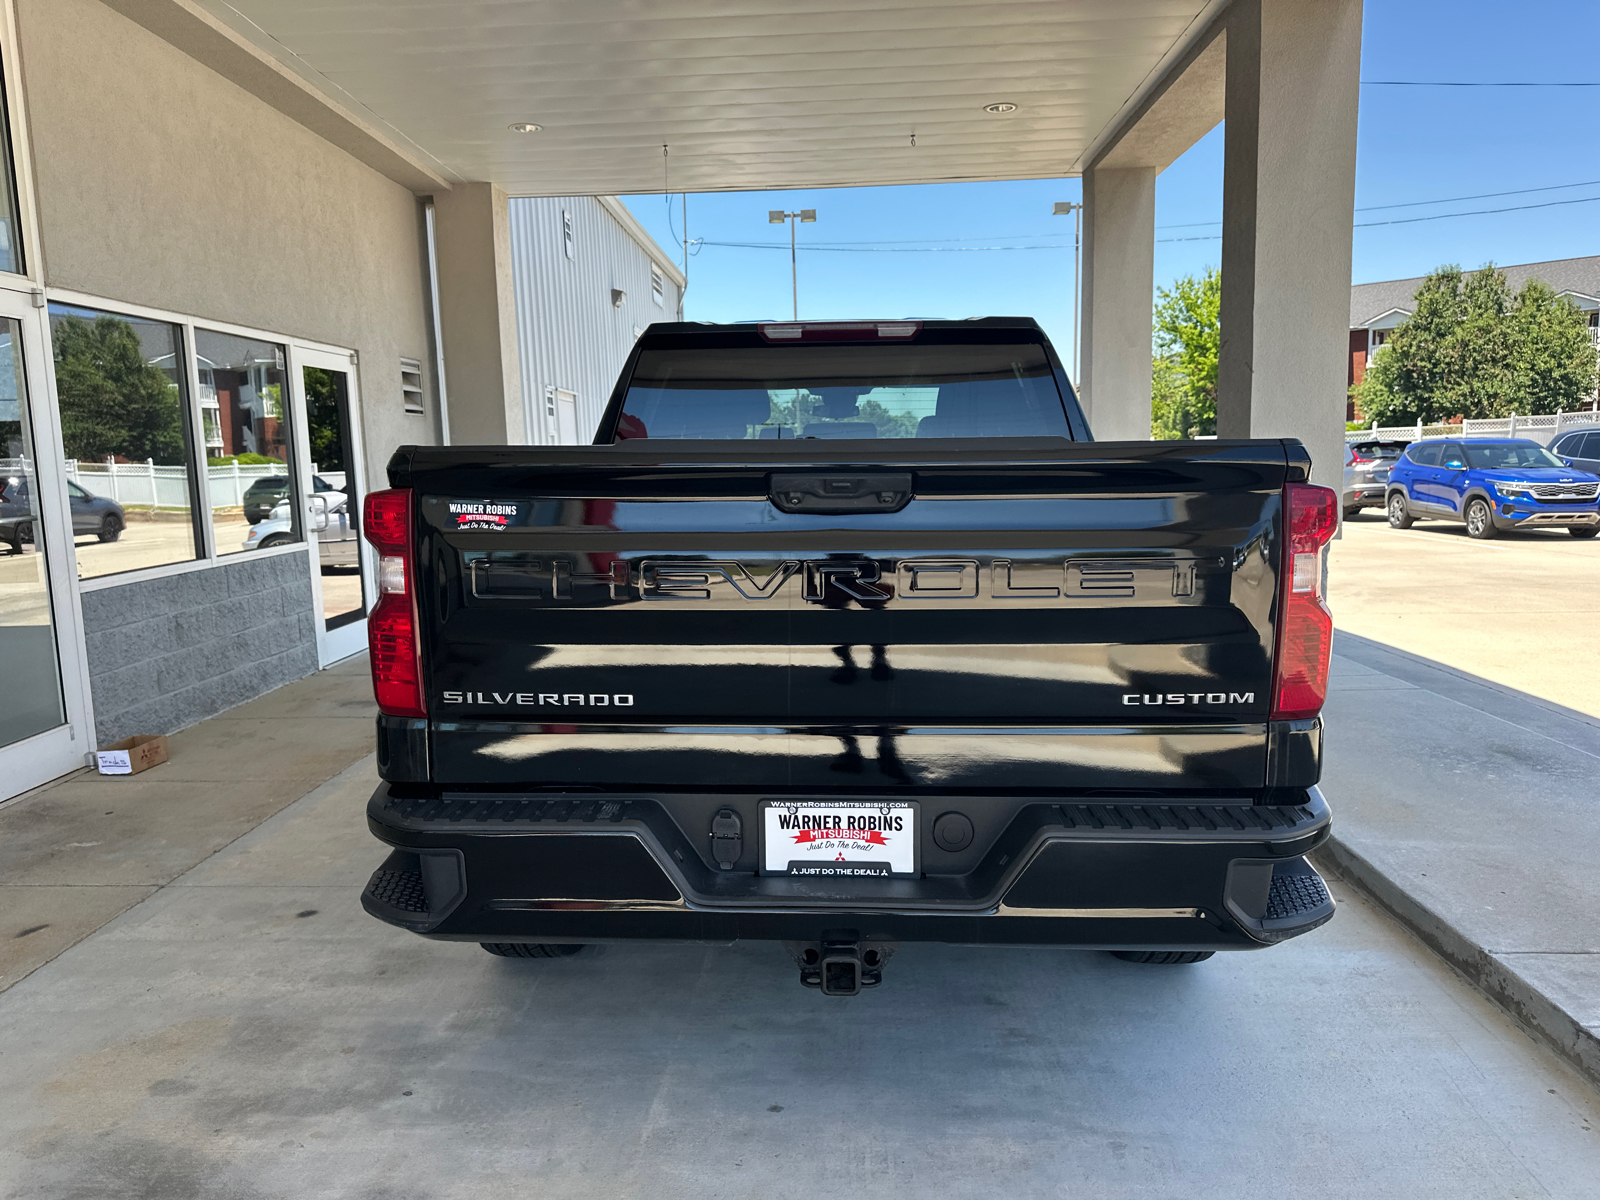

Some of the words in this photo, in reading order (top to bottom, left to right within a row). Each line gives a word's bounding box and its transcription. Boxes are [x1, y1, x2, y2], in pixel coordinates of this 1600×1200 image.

[449, 503, 484, 514] WARNER
[486, 504, 517, 515] ROBINS
[489, 523, 506, 531] Deal!
[470, 556, 1225, 602] CHEVROLET
[443, 691, 635, 706] SILVERADO
[1122, 692, 1255, 705] CUSTOM
[779, 814, 842, 830] WARNER
[847, 815, 903, 832] ROBINS
[809, 829, 871, 839] MITSUBISHI
[807, 842, 824, 851] Just
[824, 840, 835, 849] Do
[836, 840, 849, 849] The
[851, 841, 874, 852] Deal!
